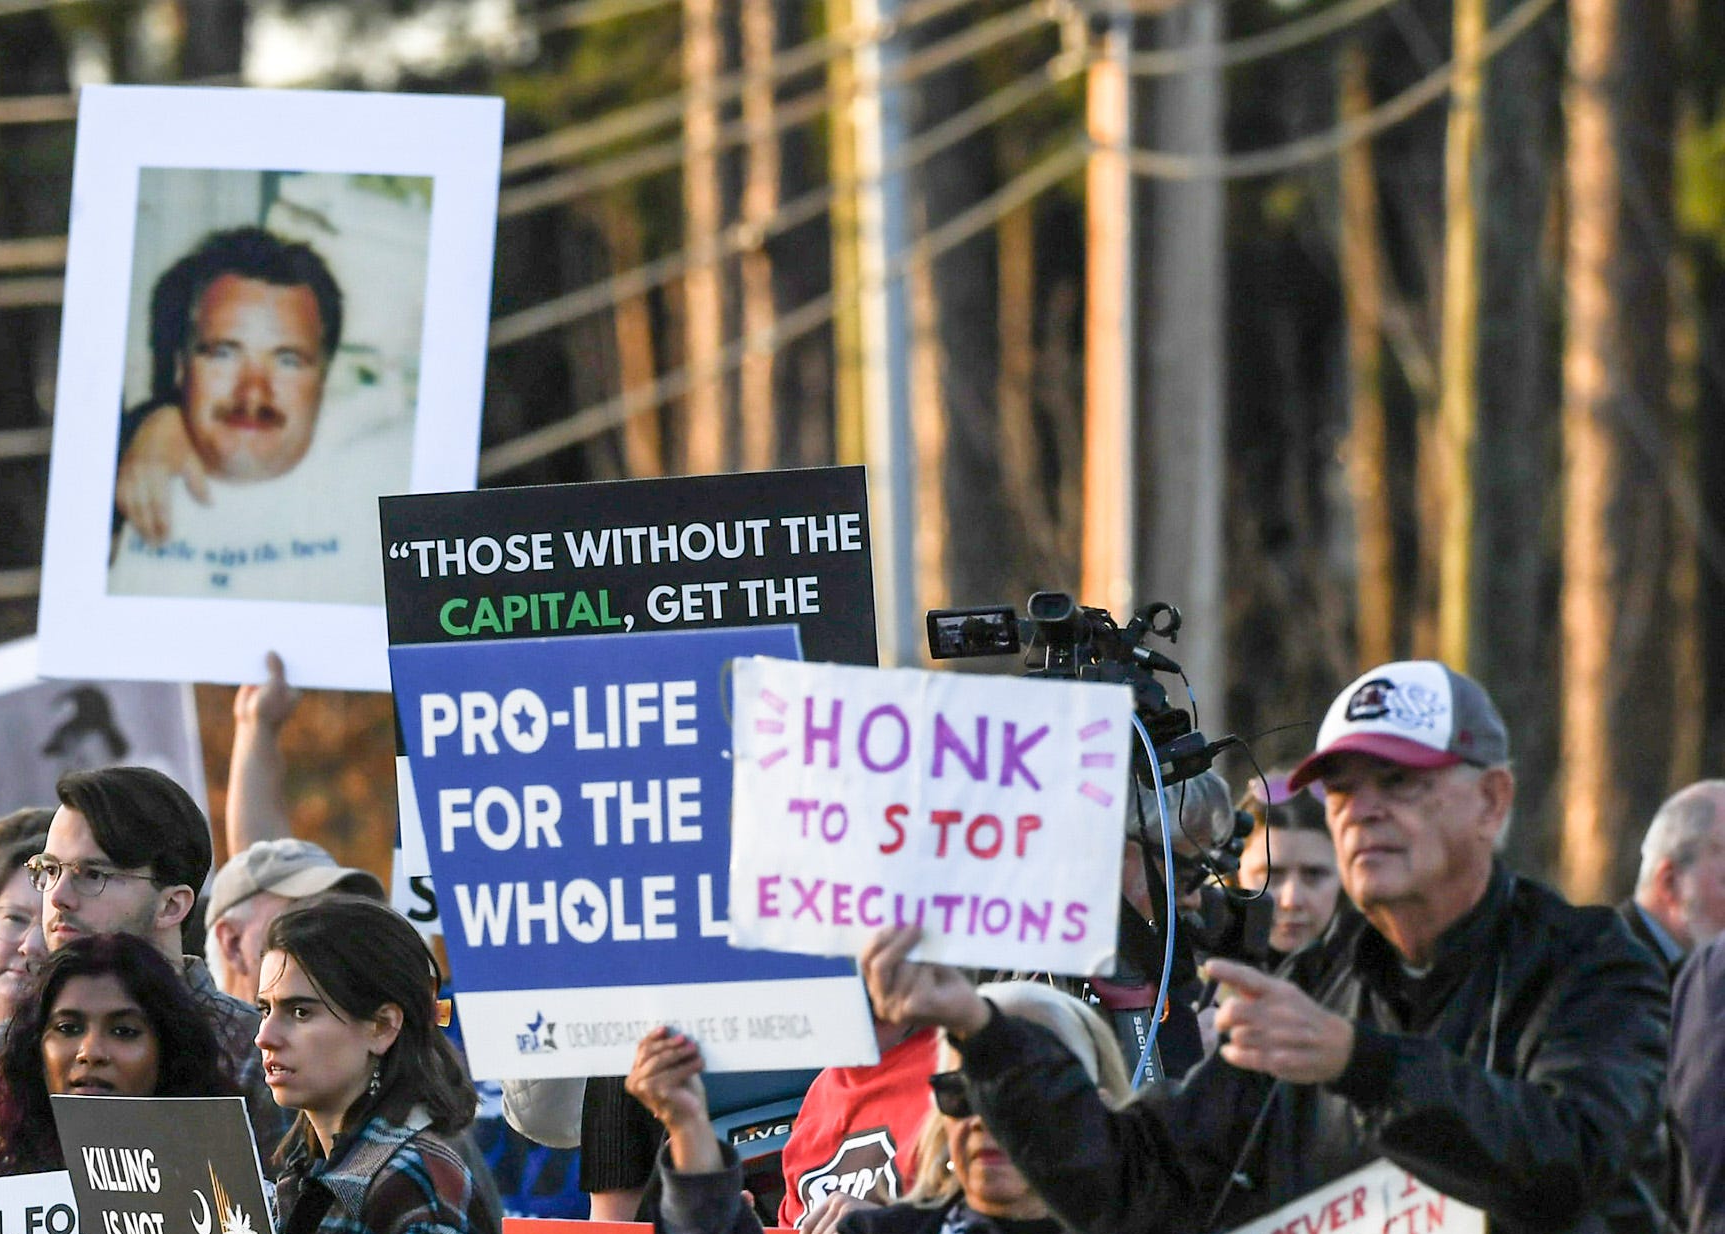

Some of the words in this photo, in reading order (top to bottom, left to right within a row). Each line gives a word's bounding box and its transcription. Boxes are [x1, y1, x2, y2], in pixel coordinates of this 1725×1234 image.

[389, 533, 554, 578] “THOSE
[563, 519, 770, 568] WITHOUT
[780, 513, 862, 554] THE
[439, 588, 635, 636] CAPITAL,
[646, 581, 729, 623] GET
[739, 576, 820, 617] THE
[419, 681, 698, 757] PRO-LIFE
[803, 697, 1049, 791] HONK
[439, 784, 562, 852] FOR
[581, 778, 702, 846] THE
[788, 799, 848, 843] TO
[879, 804, 1042, 859] STOP
[454, 874, 677, 948] WHOLE
[757, 875, 1089, 943] EXECUTIONS
[81, 1146, 162, 1193] KILLING
